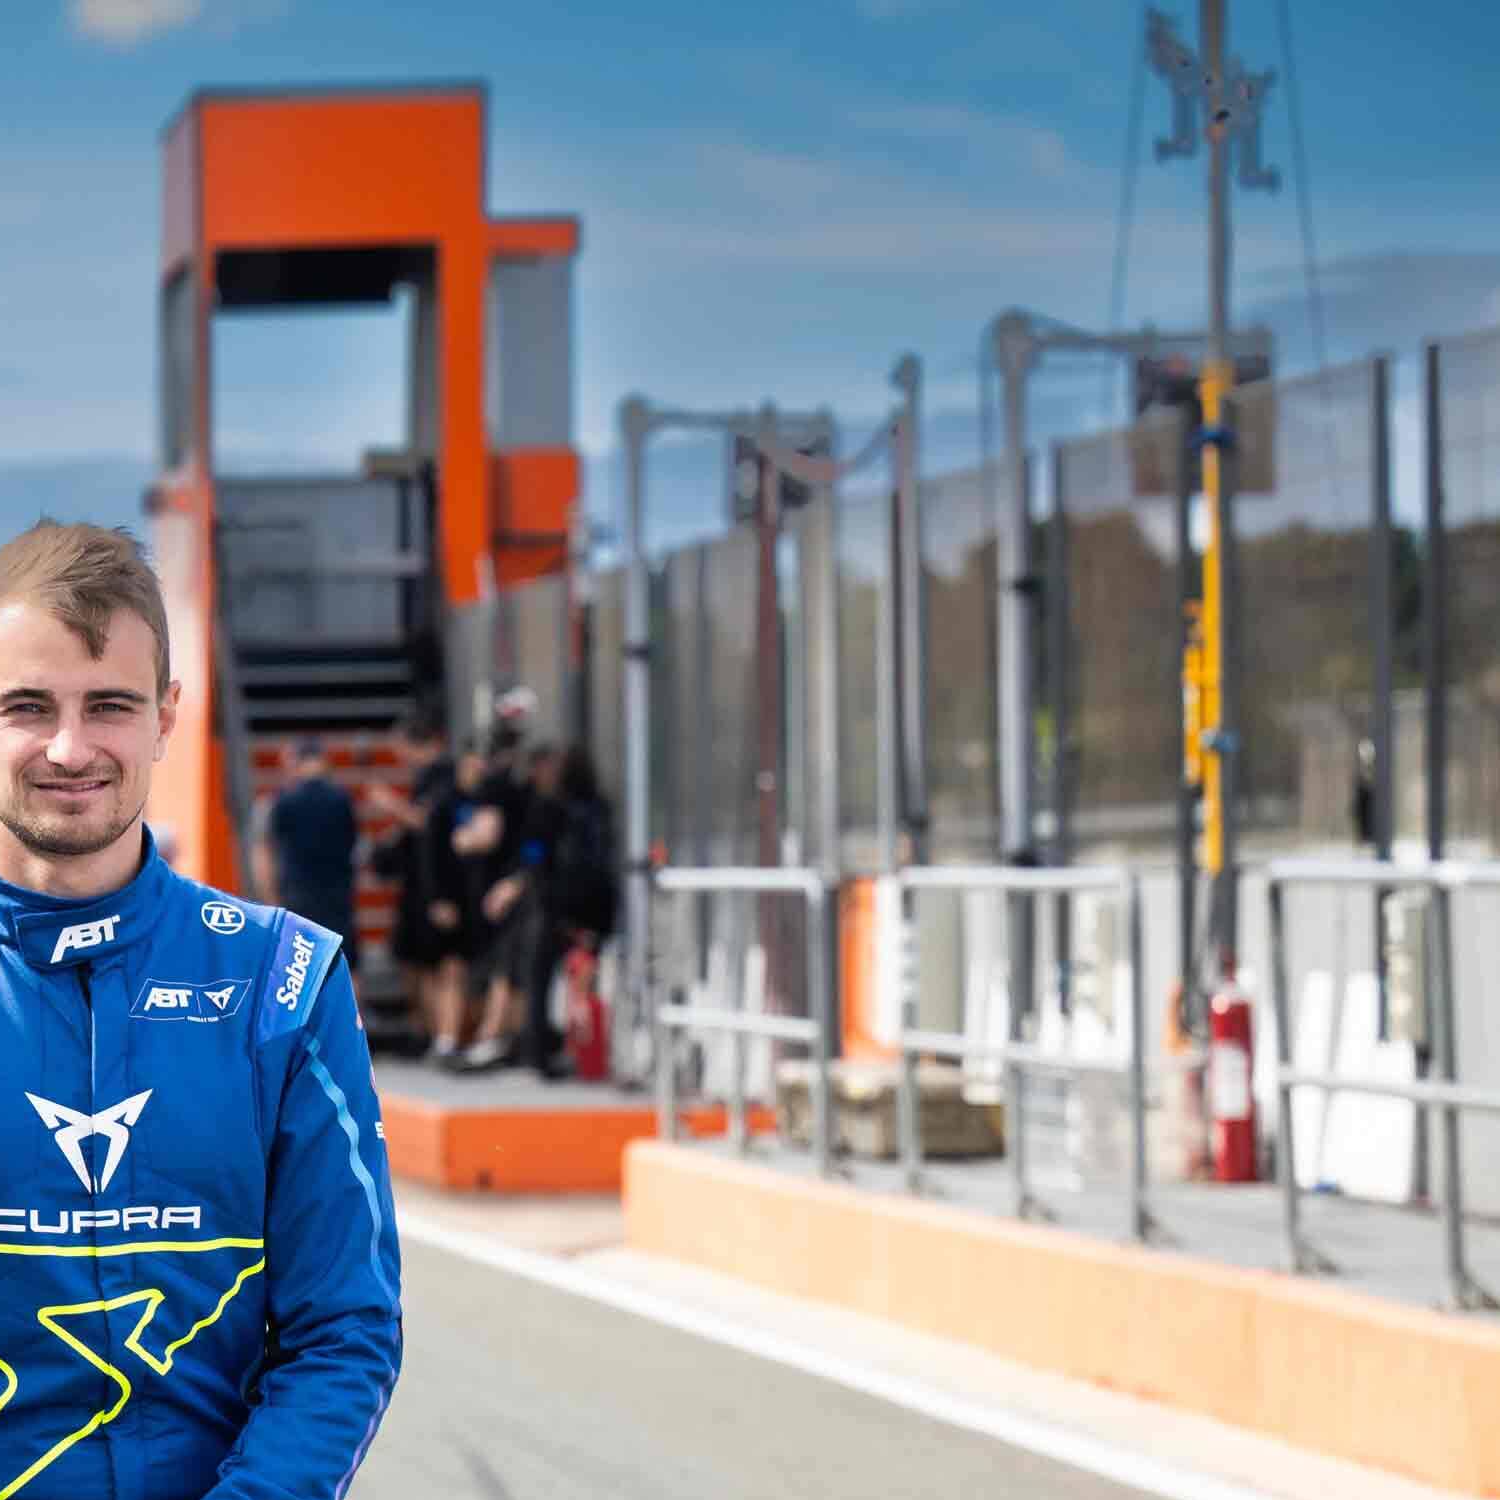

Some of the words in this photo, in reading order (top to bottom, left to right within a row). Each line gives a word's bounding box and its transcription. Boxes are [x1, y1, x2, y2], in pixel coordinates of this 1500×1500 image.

[203, 904, 244, 930] ZF
[50, 914, 121, 964] ABT
[276, 931, 315, 1011] Sabelt
[143, 987, 192, 1011] ABT
